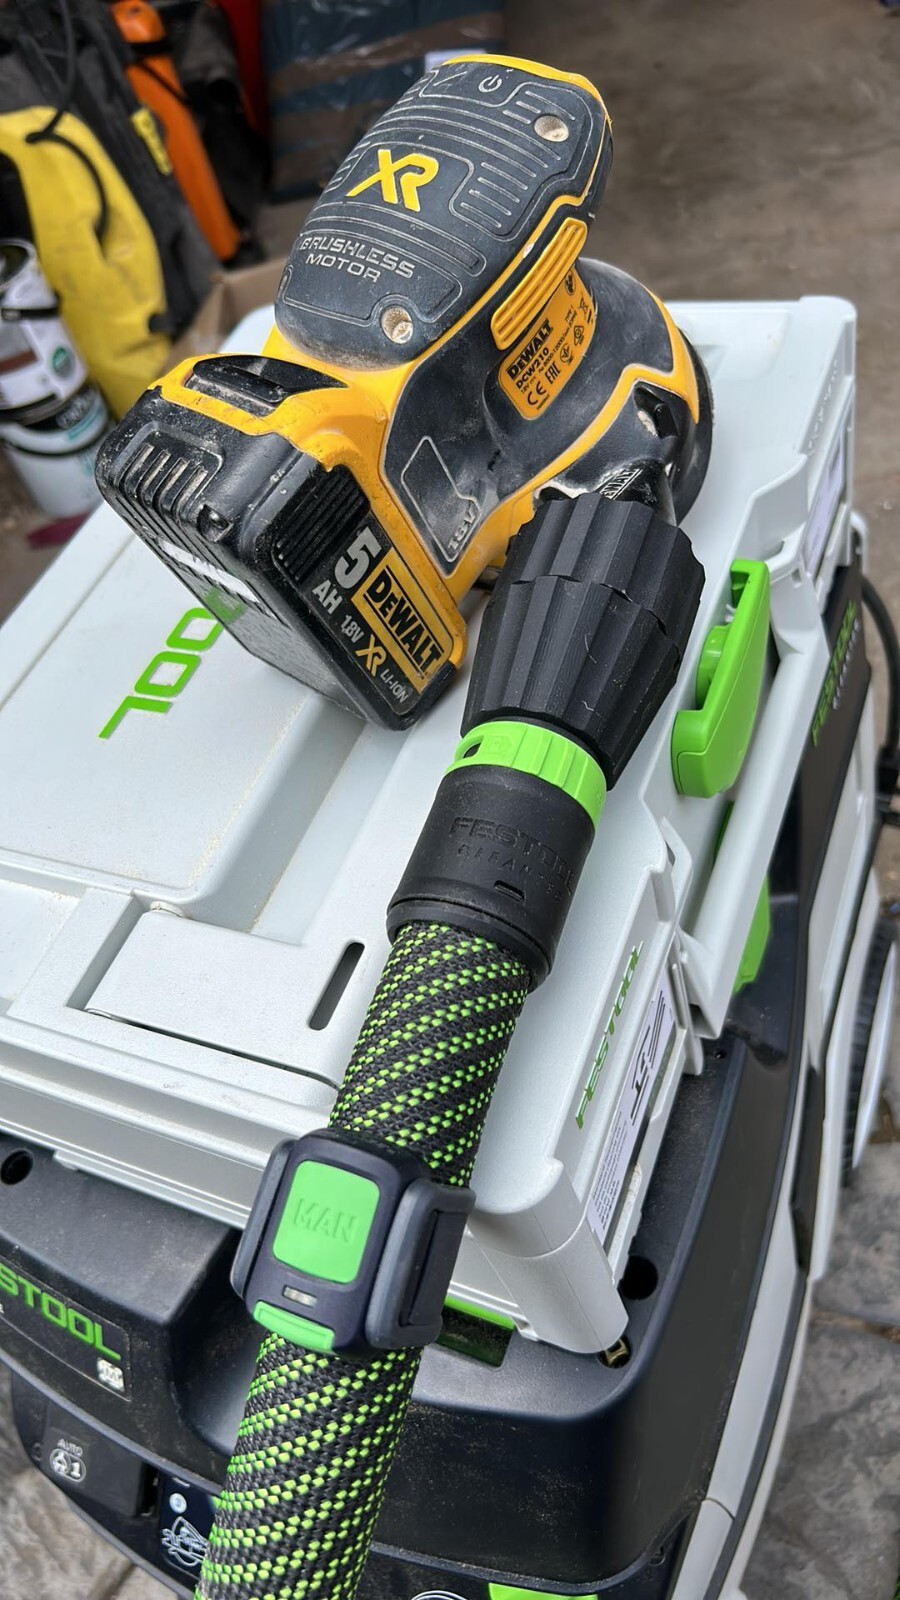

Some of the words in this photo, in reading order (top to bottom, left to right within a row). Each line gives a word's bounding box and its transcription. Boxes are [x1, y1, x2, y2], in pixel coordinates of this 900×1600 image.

[346, 149, 439, 212] XR
[300, 236, 415, 279] BRUSHLESS
[305, 253, 381, 283] MOTOR
[516, 347, 549, 389] DCW210
[600, 468, 641, 499] EWALT
[450, 506, 476, 551] 18V
[334, 526, 382, 589] 5
[312, 579, 343, 615] AH
[366, 570, 440, 673] DEWALT
[355, 634, 387, 677] XR
[380, 668, 409, 703] LI-ION
[575, 941, 643, 1130] FESTOOL
[293, 1198, 359, 1242] MAN
[0, 1263, 121, 1360] STOOL
[57, 1438, 83, 1458] AUTO
